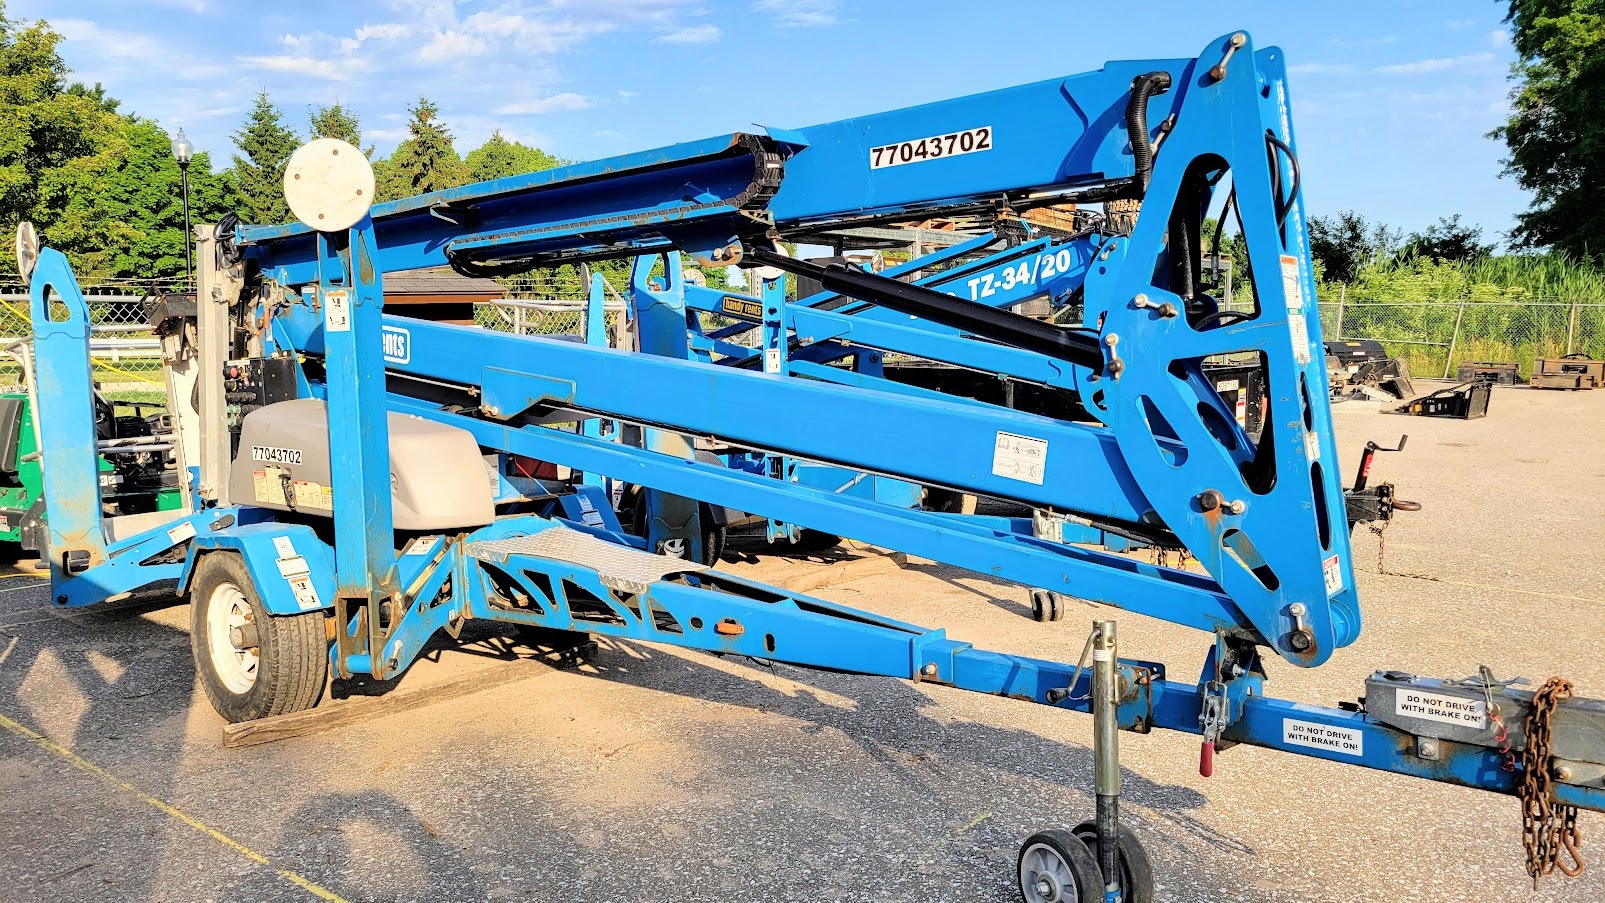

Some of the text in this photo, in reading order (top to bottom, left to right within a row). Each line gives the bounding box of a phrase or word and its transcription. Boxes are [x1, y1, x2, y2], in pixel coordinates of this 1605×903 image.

[872, 128, 990, 167] 77043702
[968, 249, 1071, 301] TZ-34/20
[725, 299, 761, 316] handy rents
[253, 446, 301, 464] 77043702
[1401, 703, 1481, 723] WITH BRAKE ON!
[1407, 695, 1475, 713] DO NOT DRIVE
[1287, 732, 1358, 751] WITH BRAKE ON!
[1292, 724, 1353, 741] DO NOT DRIVE
